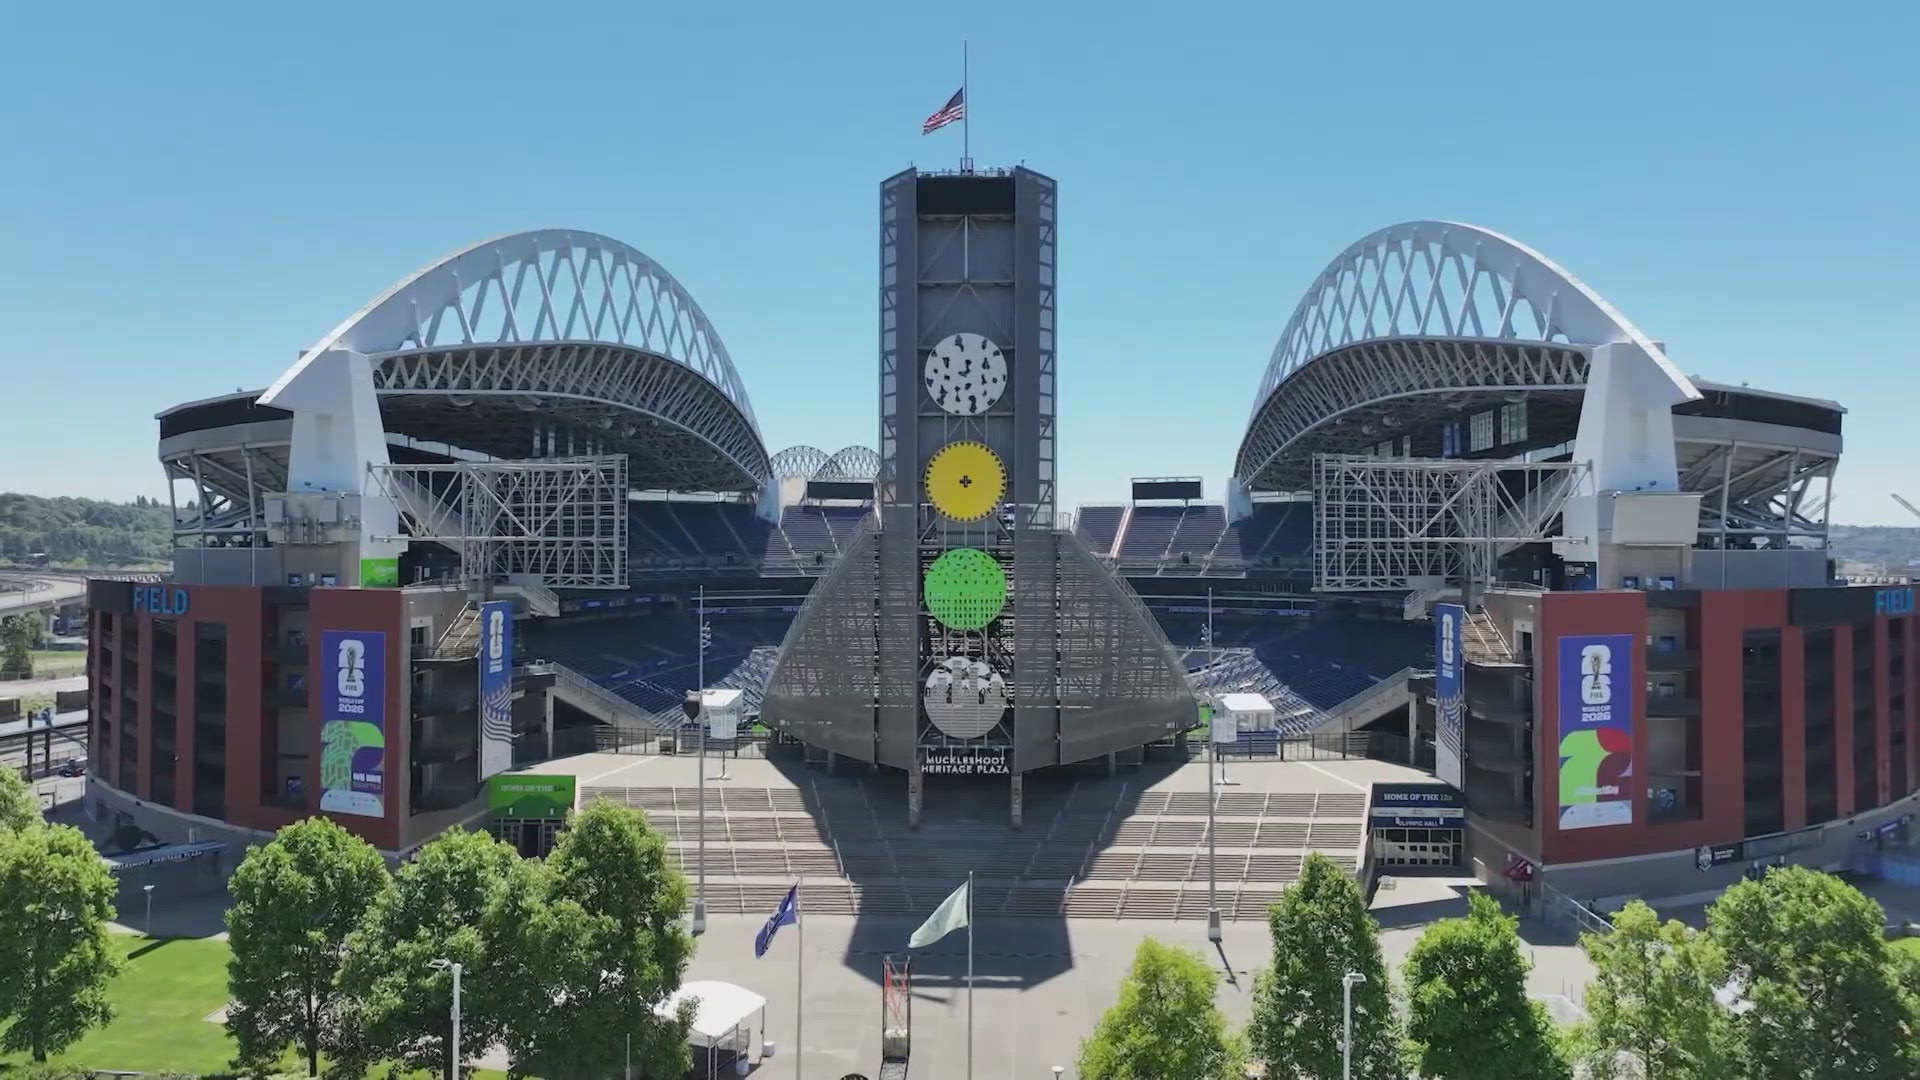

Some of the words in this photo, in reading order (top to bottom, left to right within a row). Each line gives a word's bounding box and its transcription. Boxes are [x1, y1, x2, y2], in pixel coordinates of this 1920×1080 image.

[134, 587, 188, 615] FIELD
[338, 703, 365, 714] 2026
[1581, 711, 1612, 722] 2026
[926, 756, 1006, 765] MUCKLESHOOT
[921, 764, 973, 774] HERITAGE
[977, 765, 1010, 774] PLAZA
[1383, 793, 1409, 801] HOME
[1409, 793, 1420, 801] OF
